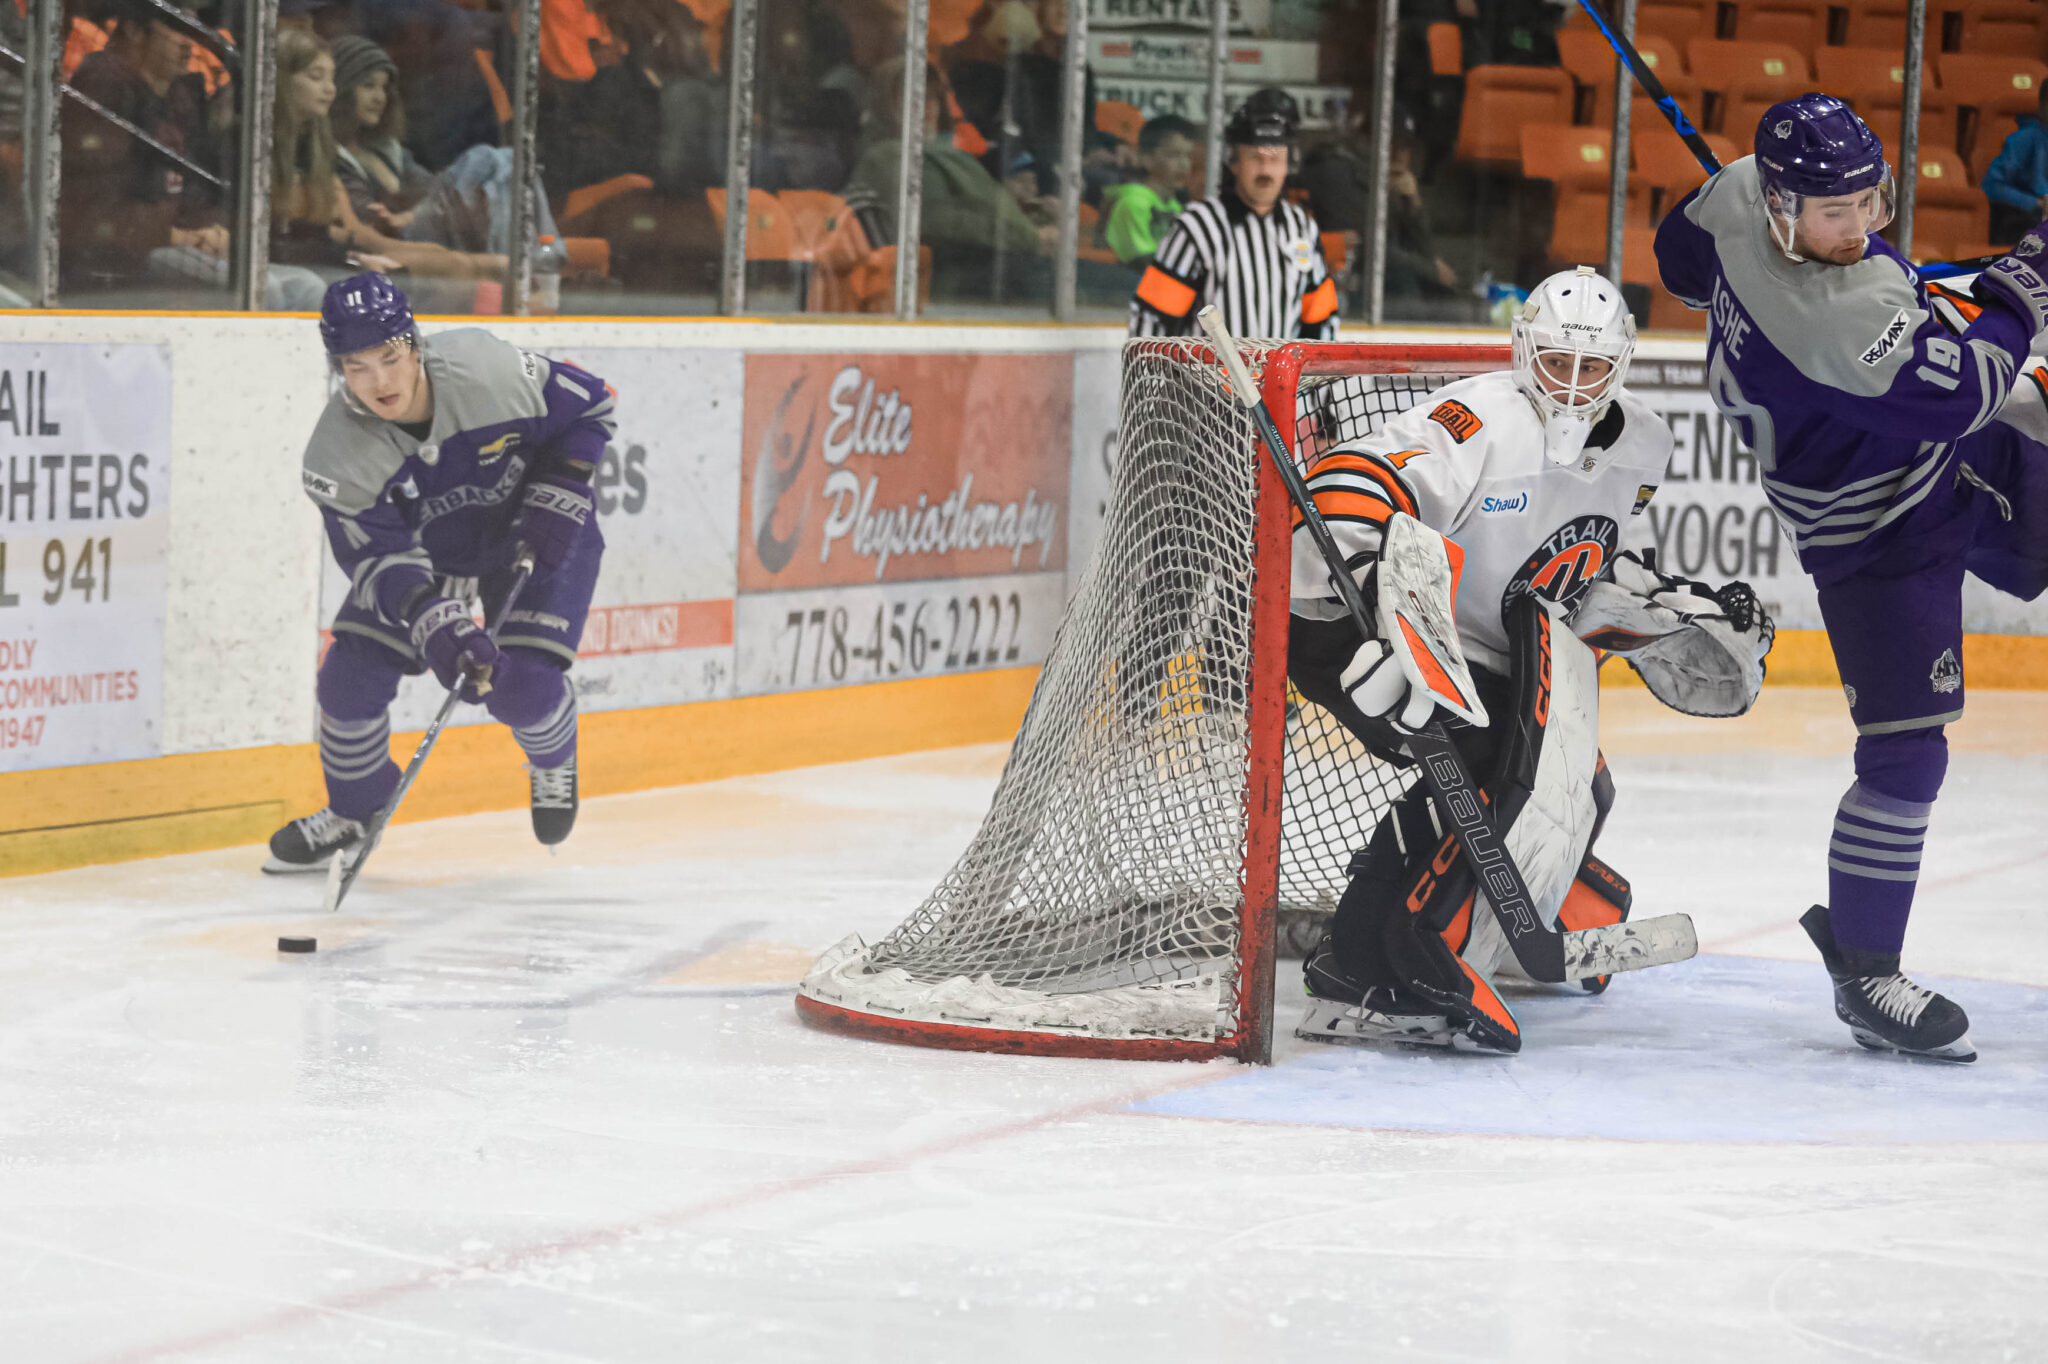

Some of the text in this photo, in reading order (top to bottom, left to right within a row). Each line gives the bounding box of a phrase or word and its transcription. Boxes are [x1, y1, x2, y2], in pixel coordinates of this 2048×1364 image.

[1107, 0, 1242, 20] RENTAS
[1561, 322, 1603, 333] BAUER
[1862, 314, 1907, 365] RE/MAX
[1915, 337, 1961, 391] 19
[823, 365, 914, 465] Elite
[0, 453, 150, 522] HTERS
[820, 469, 1058, 579] Physiotherapy
[1541, 519, 1615, 557] TRAIL
[1648, 503, 1780, 578] YOGA
[42, 537, 113, 606] 941
[787, 592, 1022, 686] 778-456-2222
[1534, 611, 1551, 728] CCM
[1425, 751, 1537, 940] BAUER
